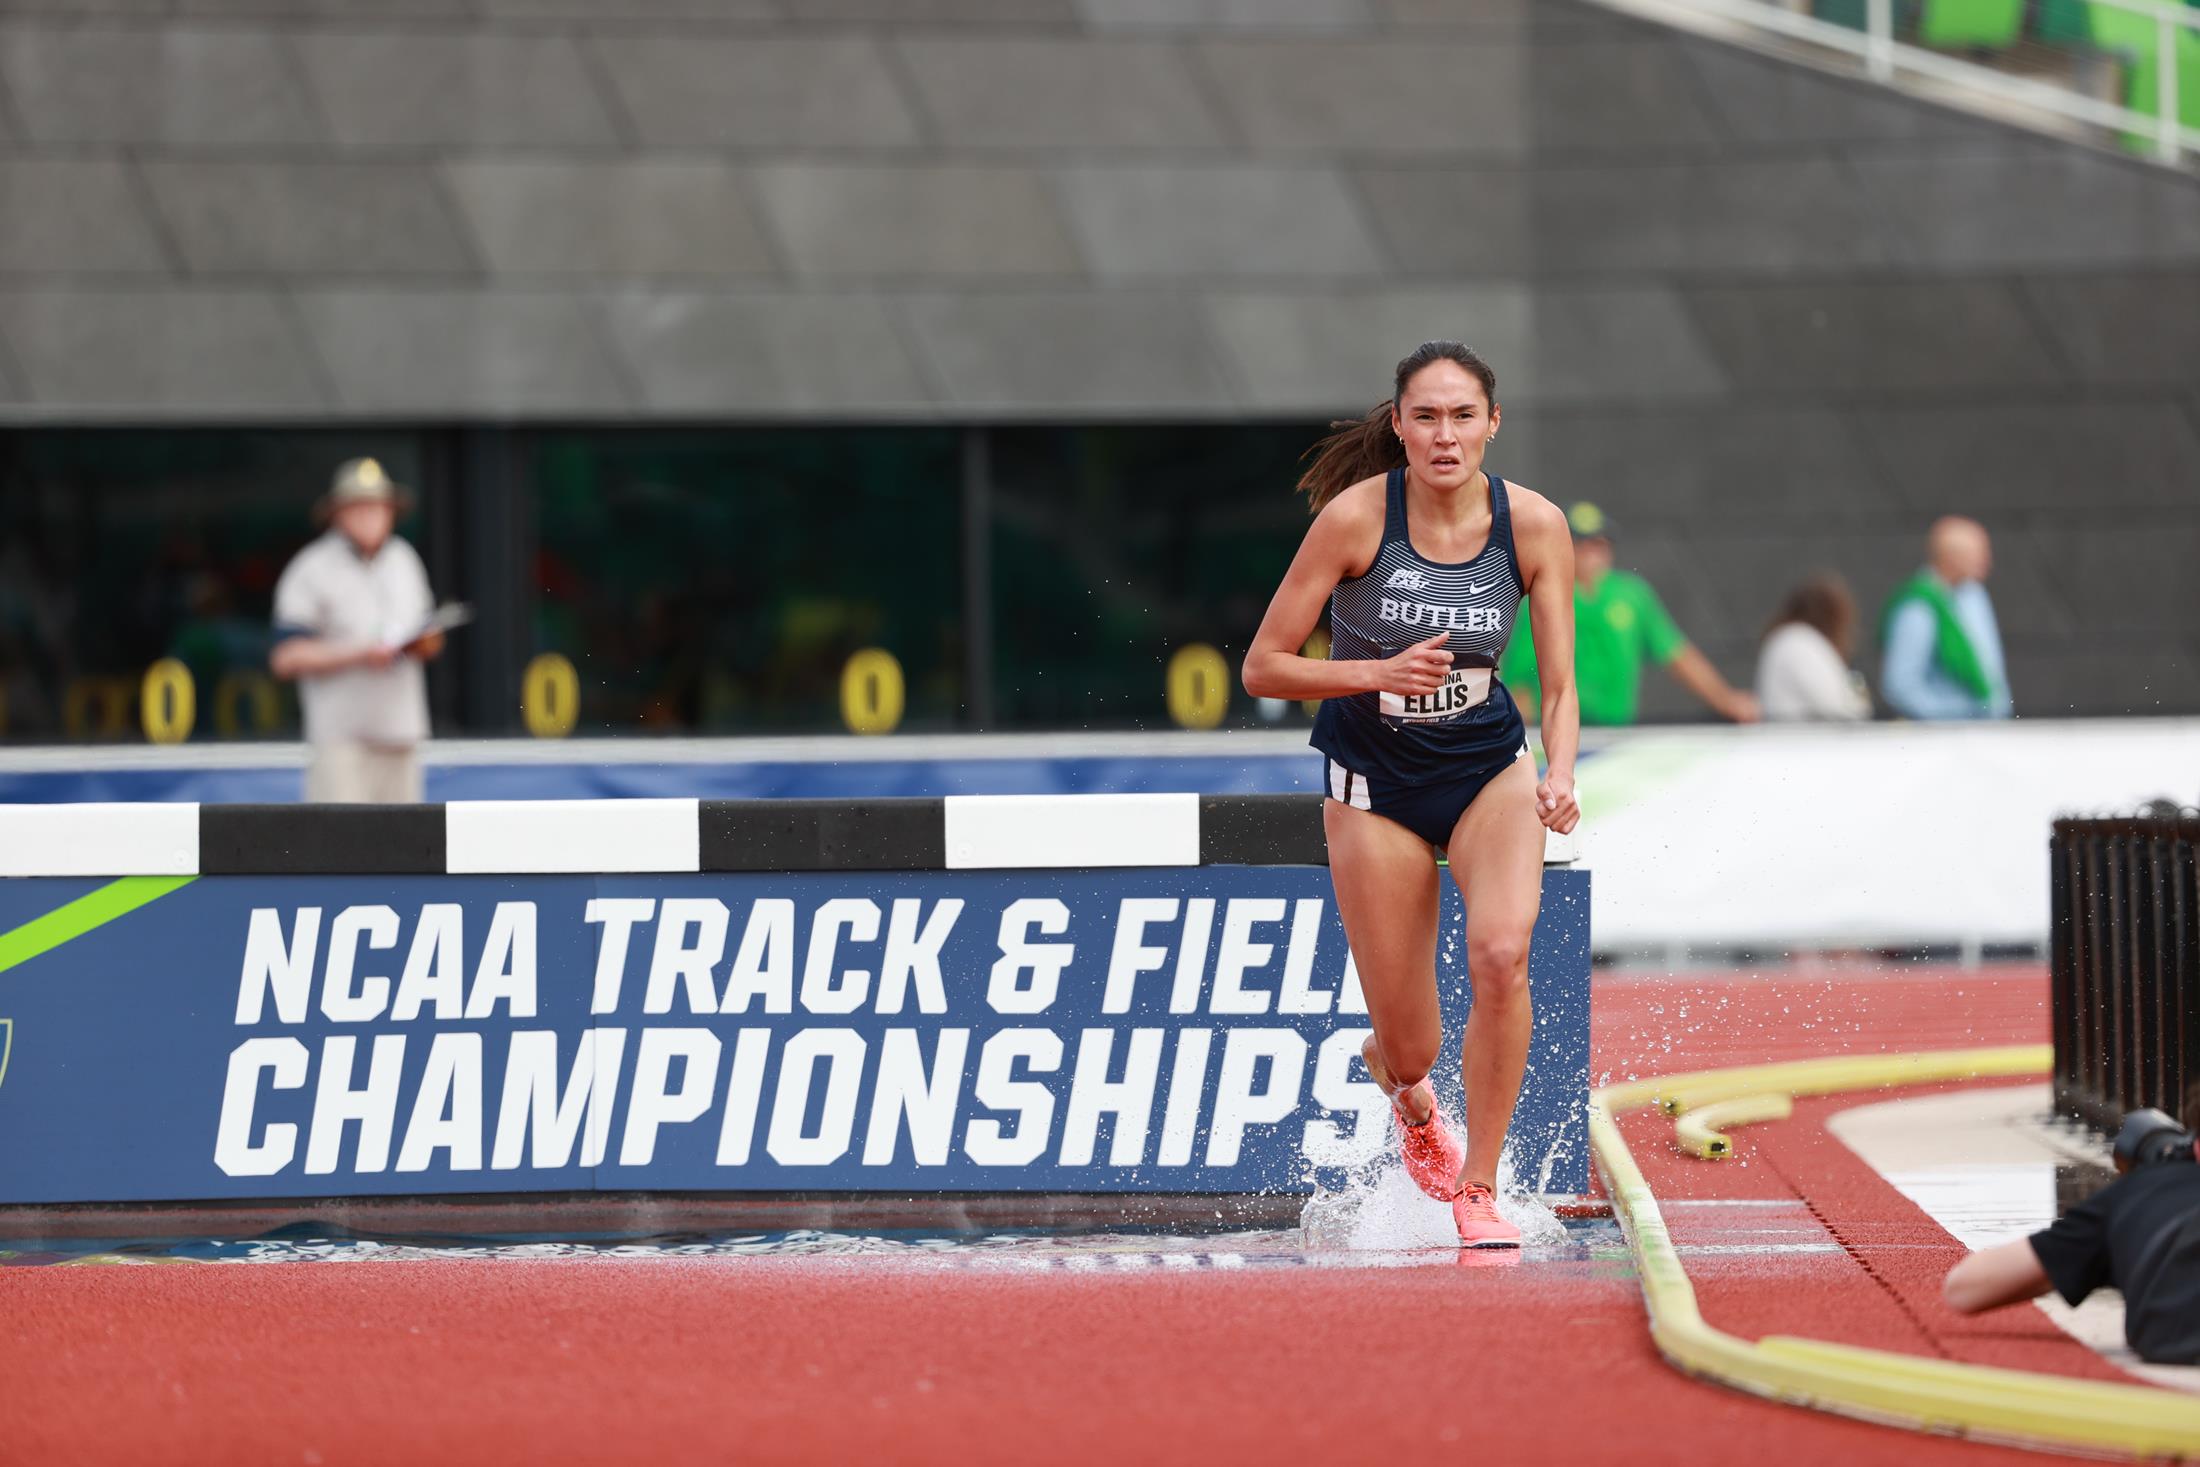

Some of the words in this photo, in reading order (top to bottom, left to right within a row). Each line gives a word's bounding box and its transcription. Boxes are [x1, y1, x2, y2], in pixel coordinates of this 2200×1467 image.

[1379, 598, 1502, 631] BUTLER
[1404, 684, 1468, 713] ELLIS
[234, 901, 537, 1025] NCAA
[584, 898, 966, 1015] TRACK
[986, 898, 1075, 1014] &
[213, 1028, 1393, 1177] CHAMPIONSHIPS
